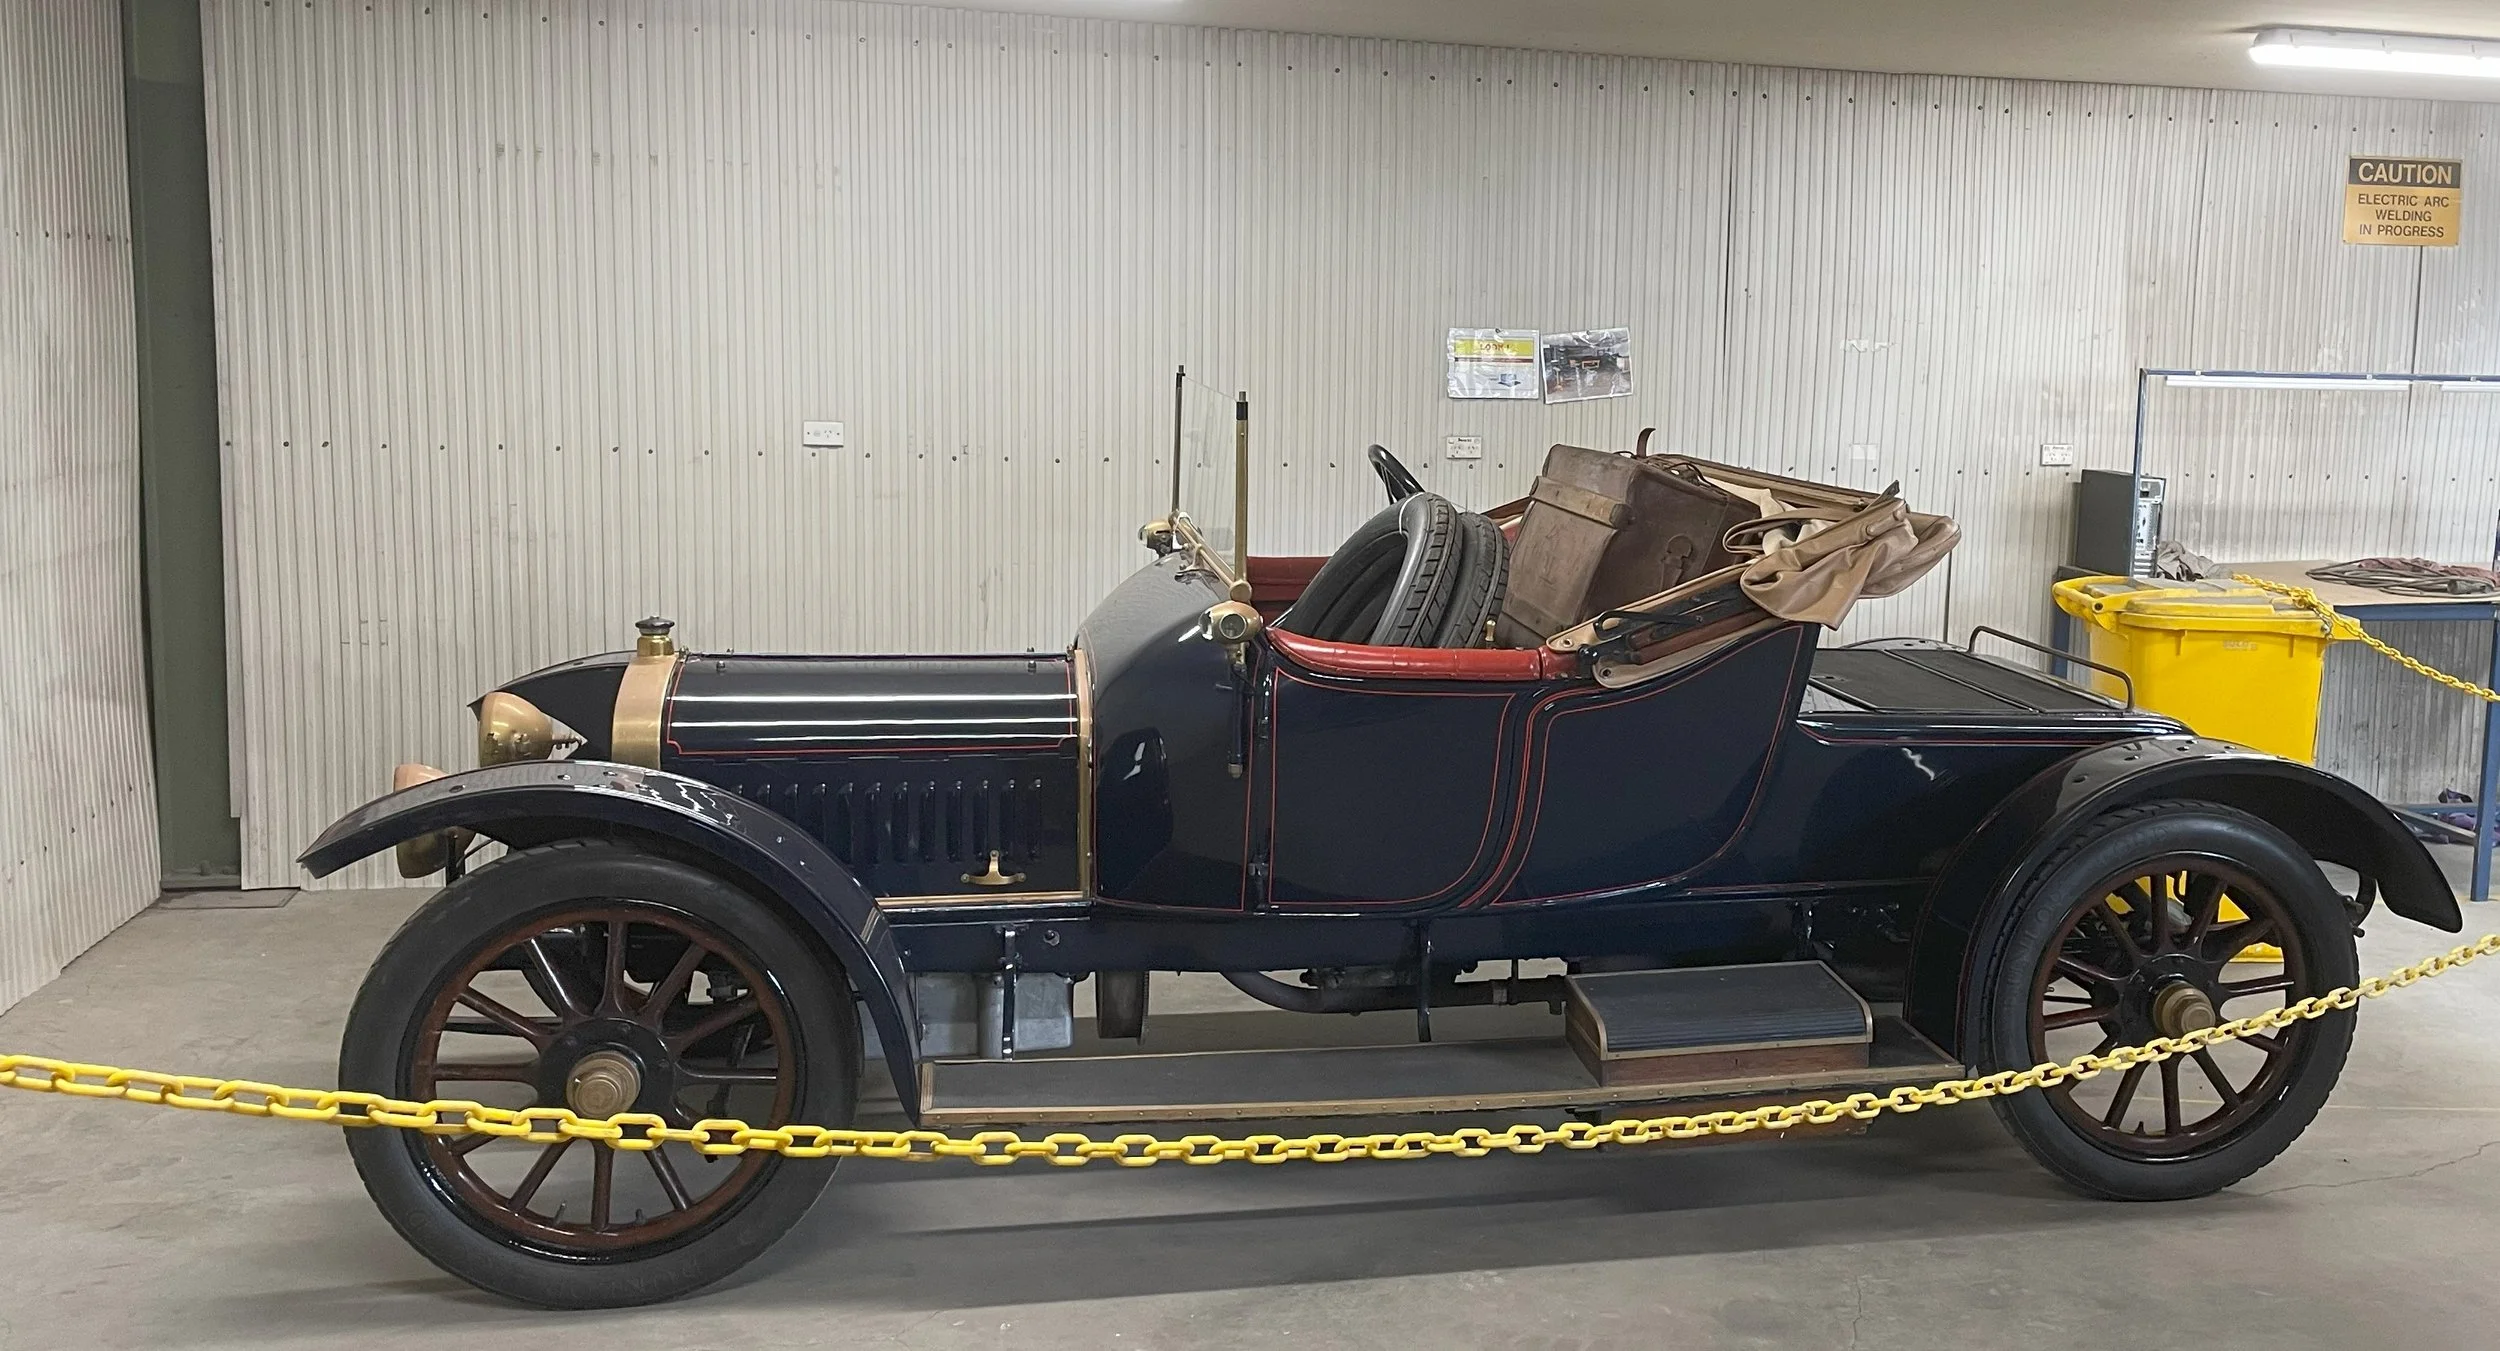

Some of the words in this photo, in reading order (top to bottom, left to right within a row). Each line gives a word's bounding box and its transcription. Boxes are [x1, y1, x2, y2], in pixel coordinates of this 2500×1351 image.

[2358, 162, 2452, 184] CAUTION
[2358, 193, 2418, 206] ELECTRIC
[2424, 196, 2449, 207] ARC
[2375, 209, 2432, 221] WELDING
[2359, 224, 2372, 235] IN
[2377, 225, 2444, 238] PROGRESS
